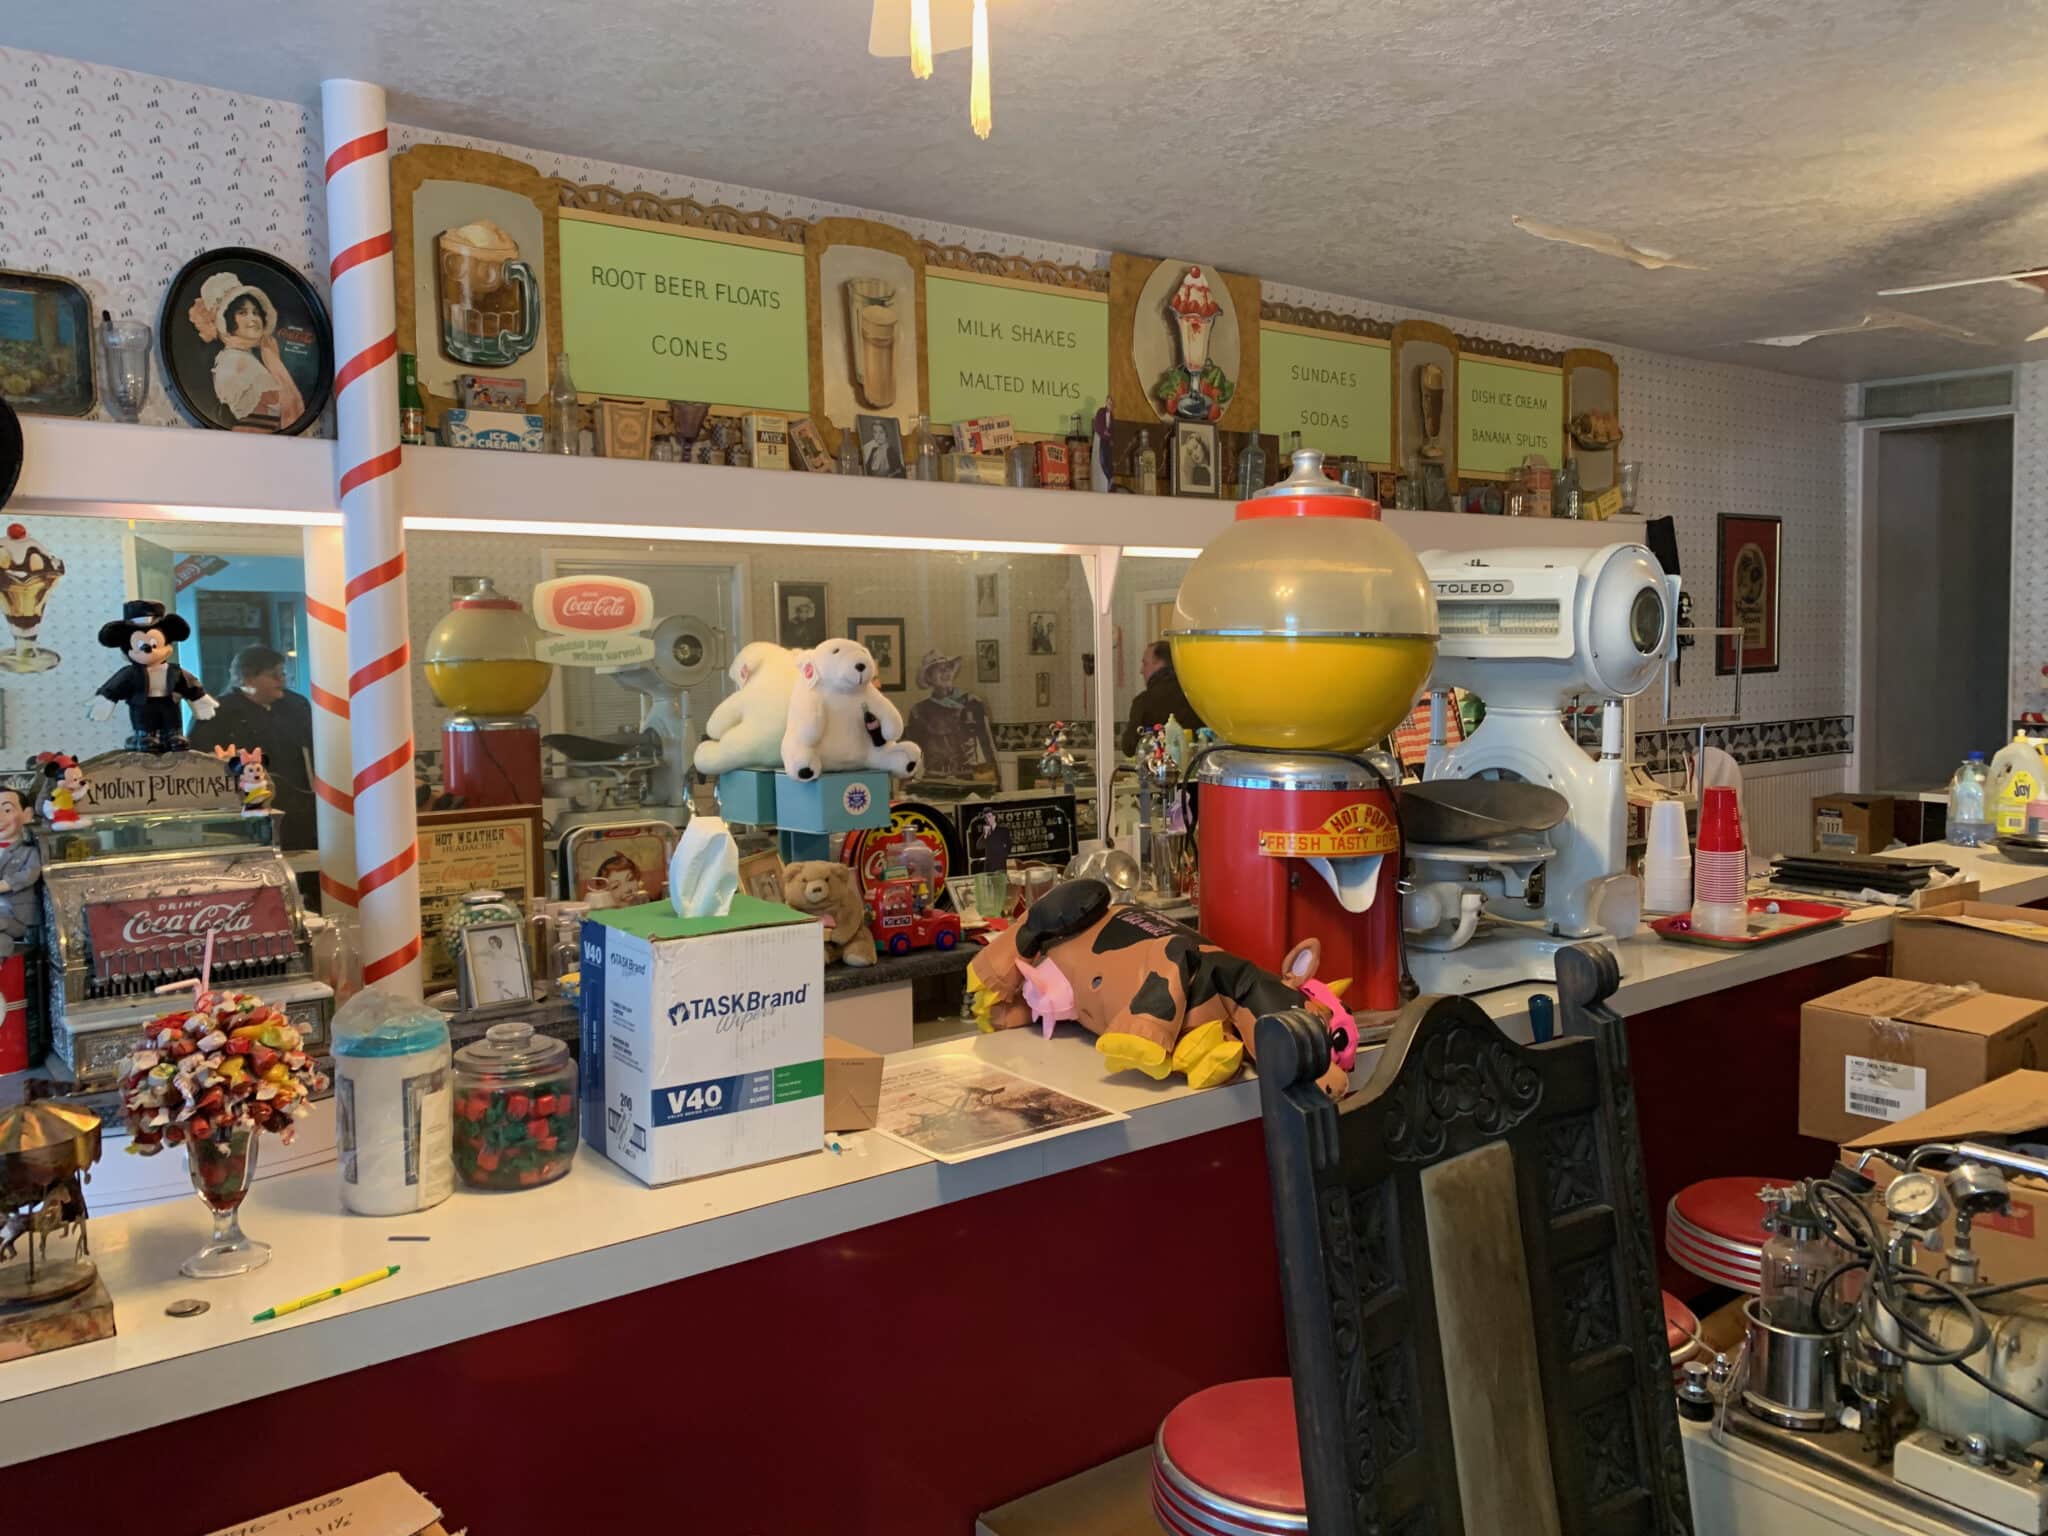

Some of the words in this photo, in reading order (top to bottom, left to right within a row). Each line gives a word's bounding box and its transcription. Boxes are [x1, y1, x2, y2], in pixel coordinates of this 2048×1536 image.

[591, 266, 647, 291] ROOT
[654, 274, 709, 300] BEER
[715, 283, 781, 310] FLOATS
[957, 317, 1003, 340] MILK
[1011, 324, 1077, 349] SHAKES
[652, 334, 728, 361] CONES
[960, 371, 1025, 393] MALTED
[1032, 379, 1080, 400] MILKS
[1291, 364, 1357, 388] SUNDAES
[1472, 389, 1496, 405] DISH
[1499, 393, 1512, 407] ICE
[1515, 394, 1548, 410] CREAM
[1300, 409, 1349, 429] SODAS
[489, 432, 508, 441] ICE
[1472, 428, 1512, 445] BANANA
[1516, 432, 1548, 448] SPLITS
[1437, 583, 1505, 593] TOLEDO
[562, 595, 625, 616] Coca-Cola
[1330, 807, 1359, 833] HOT
[435, 833, 453, 846] HOT
[458, 828, 505, 844] WEATHER
[1266, 835, 1321, 851] FRESH
[1329, 834, 1368, 851] TASTY
[158, 900, 202, 911] DRINK
[122, 901, 255, 943] Coca-Cola
[584, 940, 602, 964] V40
[667, 1085, 722, 1115] V40
